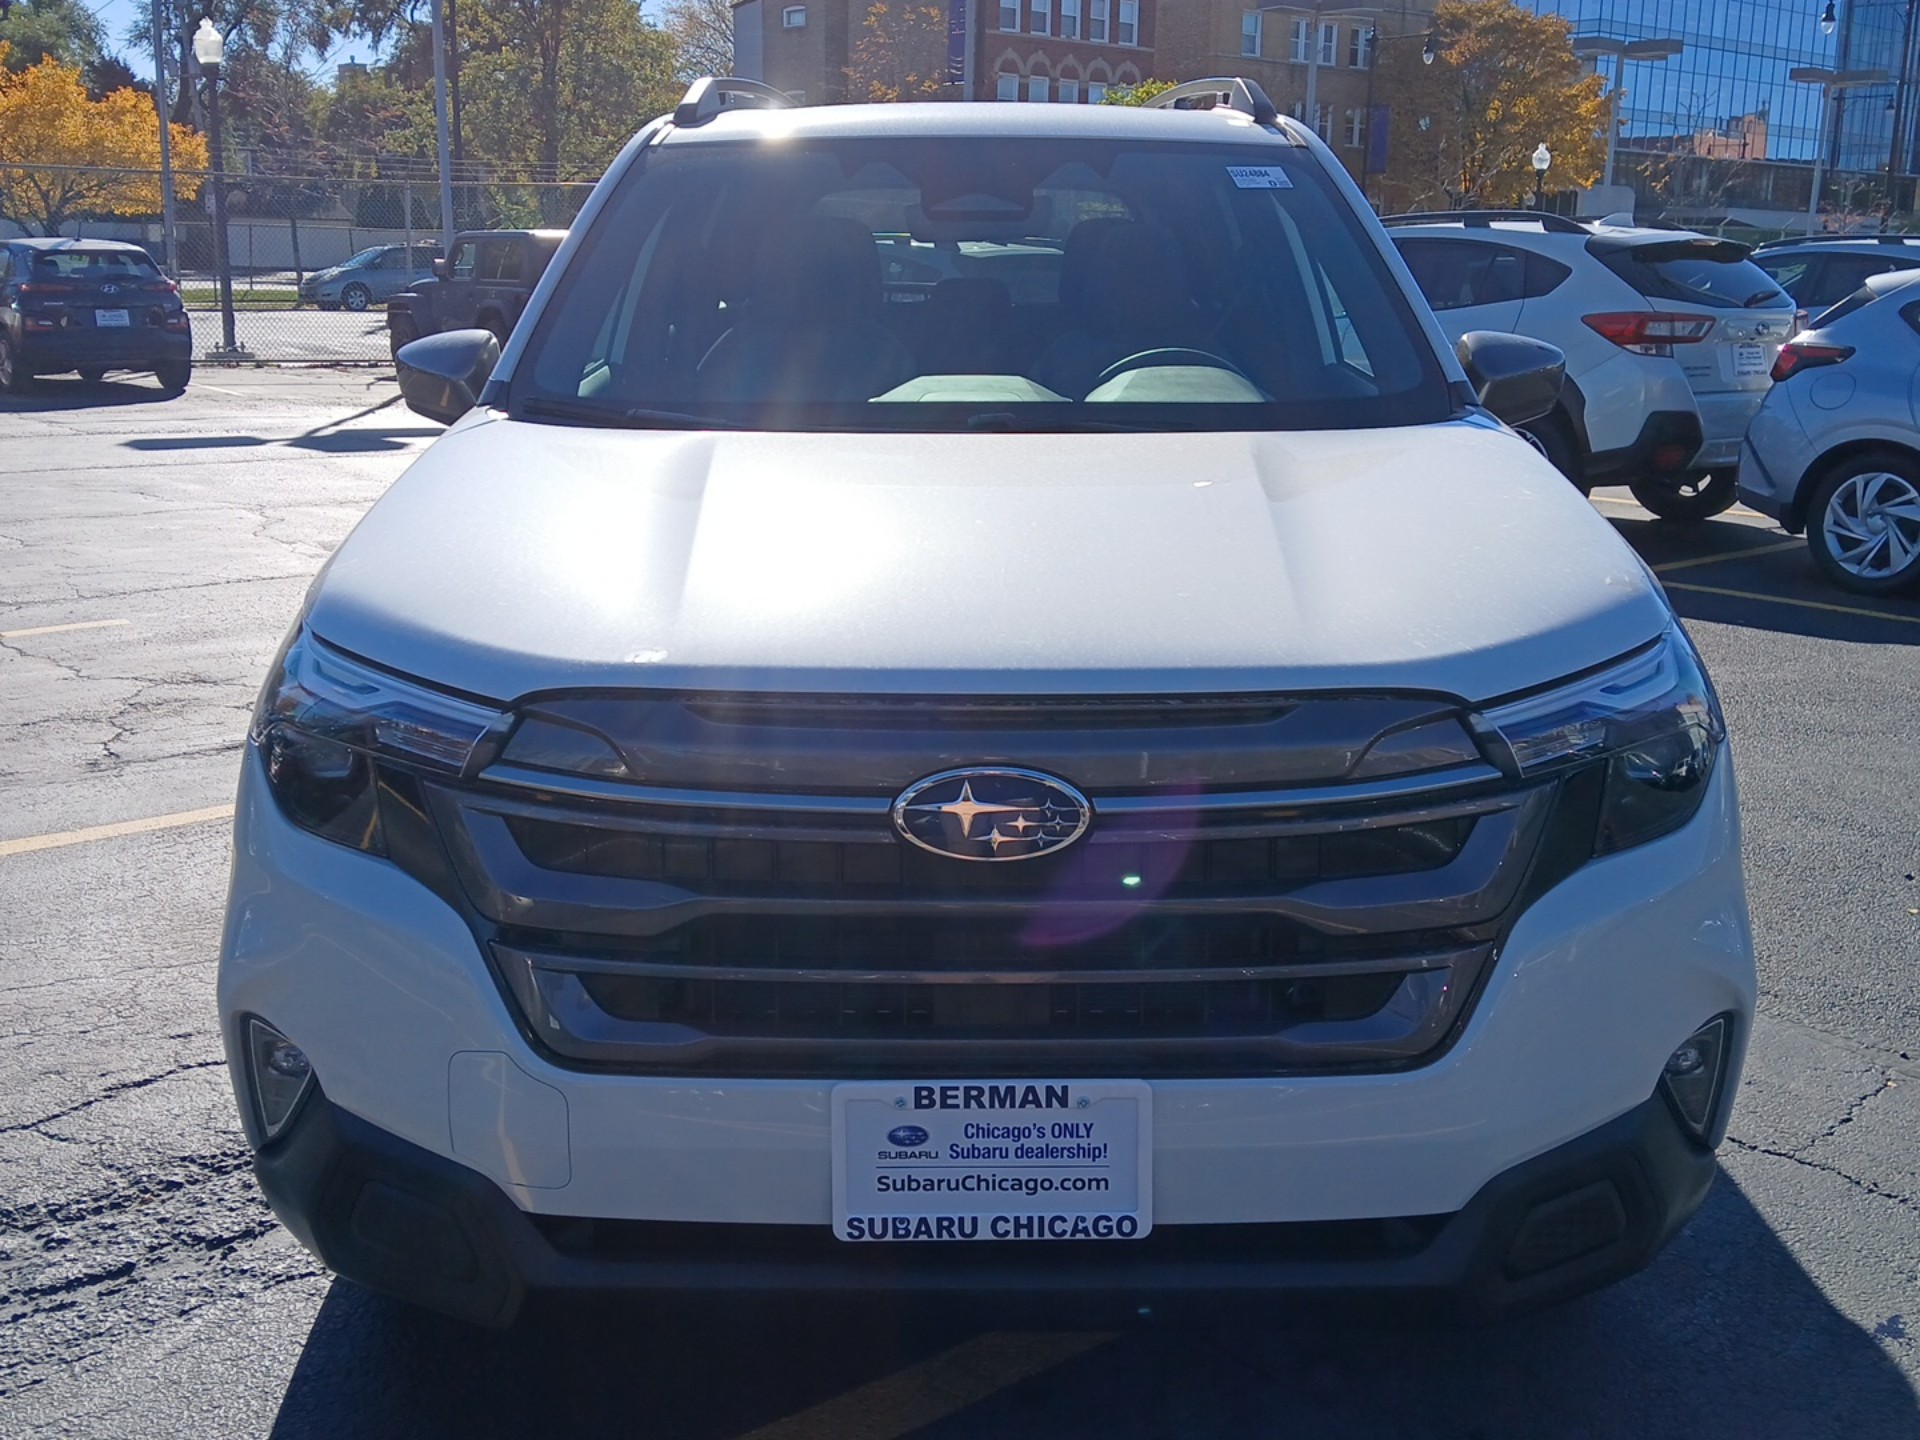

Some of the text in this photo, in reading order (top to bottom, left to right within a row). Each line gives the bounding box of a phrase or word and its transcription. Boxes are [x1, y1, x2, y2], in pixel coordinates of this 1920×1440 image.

[913, 1085, 1070, 1110] BERMAN
[963, 1122, 1094, 1142] Chicago's ONLY
[877, 1151, 939, 1160] SUBARU
[948, 1143, 1108, 1162] Subaru dealership!
[876, 1174, 1110, 1196] SubaruChicago.com
[846, 1215, 1138, 1240] SUBARU CHICAGO
